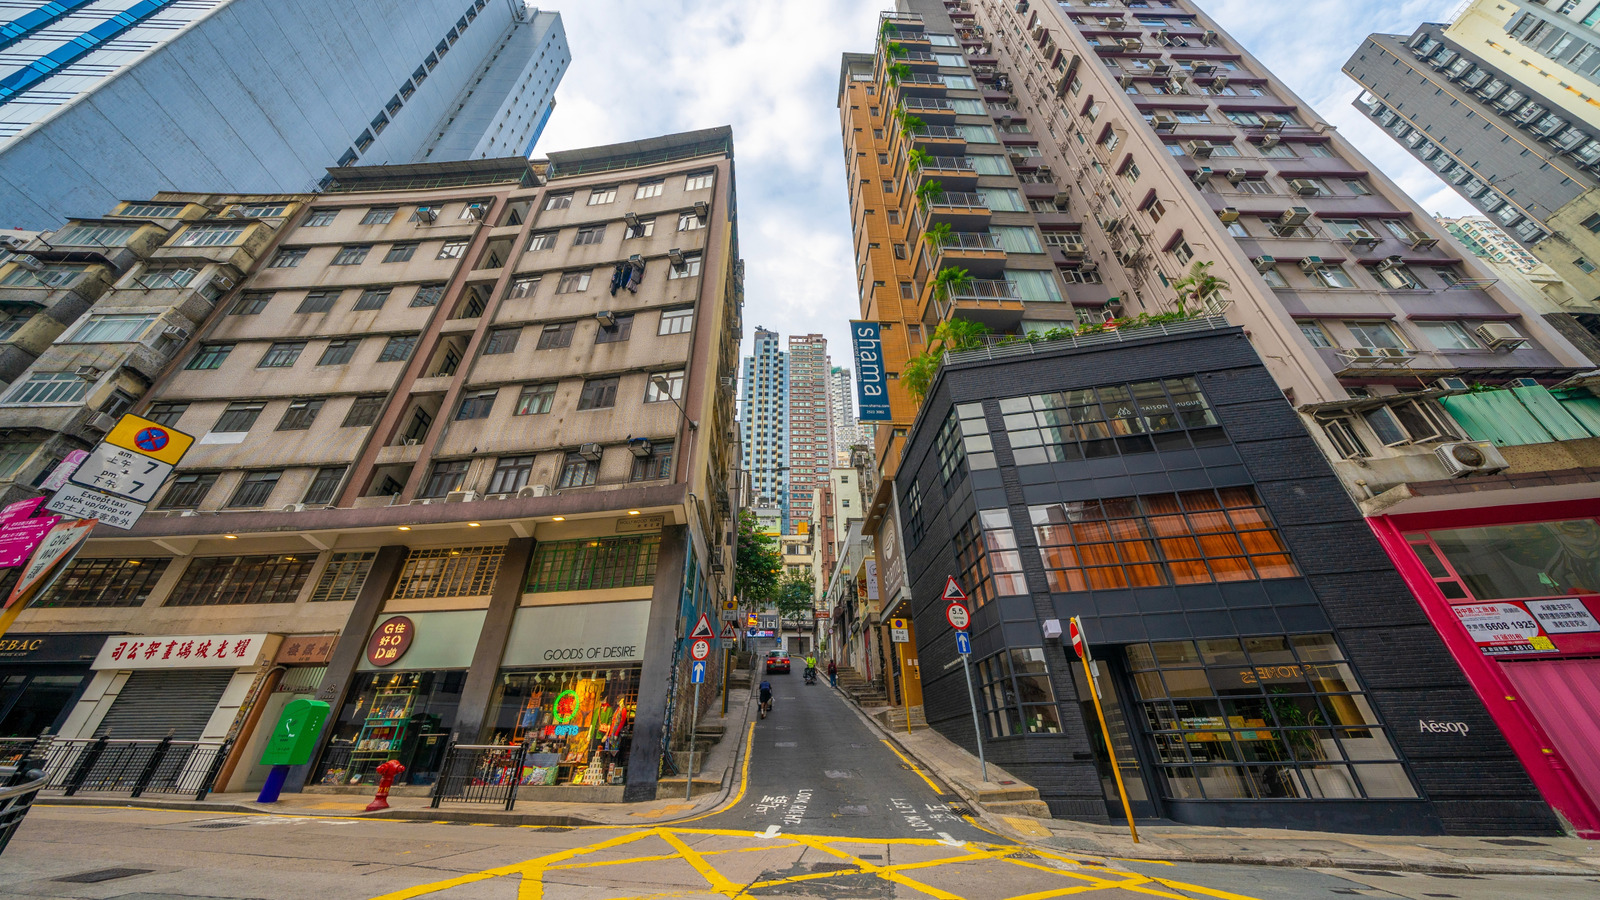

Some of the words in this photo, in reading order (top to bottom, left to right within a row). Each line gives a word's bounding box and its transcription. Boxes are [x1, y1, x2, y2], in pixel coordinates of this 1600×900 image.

[858, 328, 882, 396] shama
[106, 456, 131, 467] 上午
[118, 450, 133, 459] am
[100, 470, 117, 480] pm
[143, 461, 159, 475] 7
[93, 475, 117, 489] 下午
[128, 480, 145, 494] 7
[64, 494, 83, 505] pick
[84, 500, 118, 515] up/drop
[80, 490, 110, 504] Except
[111, 499, 128, 509] taxi
[49, 532, 74, 547] GIVE
[39, 547, 61, 560] WAY
[951, 607, 964, 615] 5.5
[1485, 621, 1509, 631] 6608
[1511, 620, 1536, 629] 1925
[696, 642, 706, 650] 5.5
[543, 648, 584, 661] GOODS
[586, 647, 602, 659] OF
[603, 646, 637, 658] DESIRE
[1418, 719, 1470, 737] Aēsop
